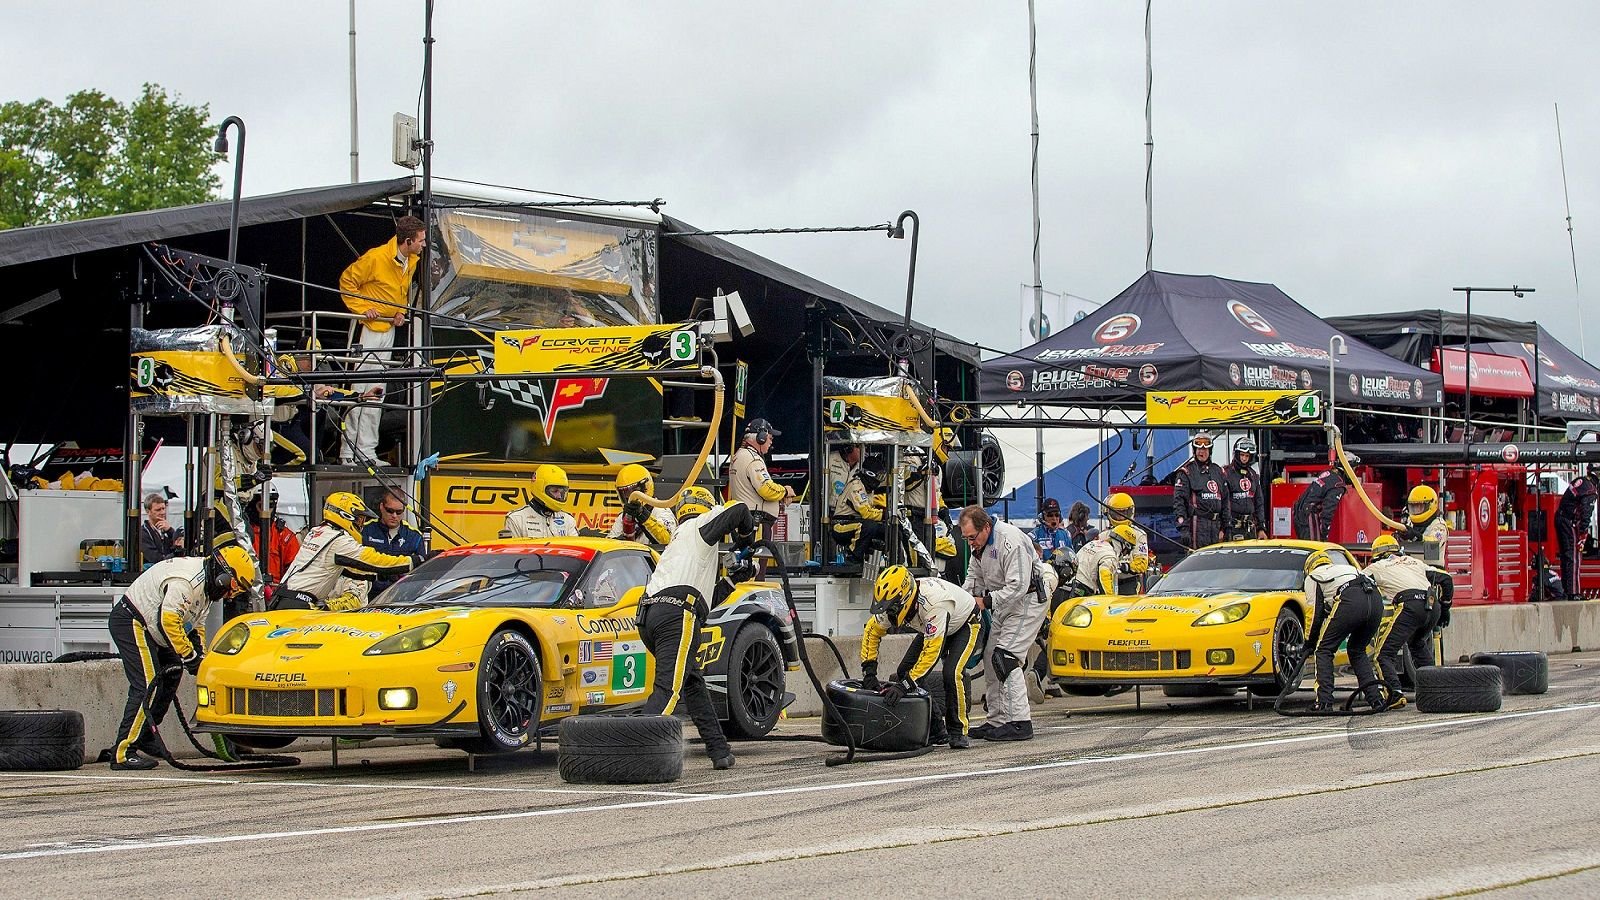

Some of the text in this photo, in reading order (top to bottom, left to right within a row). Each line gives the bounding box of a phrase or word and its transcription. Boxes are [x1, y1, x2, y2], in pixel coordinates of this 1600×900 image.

[541, 336, 632, 347] CORVETTE
[676, 332, 693, 359] 3
[569, 345, 629, 354] RACING
[140, 359, 152, 386] 3
[1142, 367, 1154, 385] 5
[1245, 378, 1297, 390] MOTORSPORTS
[1362, 388, 1411, 400] MOTORSPORTS
[1187, 398, 1265, 406] CORVETTE
[1302, 396, 1316, 417] 4
[832, 401, 843, 422] 4
[1519, 448, 1587, 458] motorspots
[446, 485, 623, 506] CORTTE
[577, 614, 638, 639] Compuw
[1107, 639, 1151, 647] FLEXFUEL
[254, 672, 308, 682] FLEXFUEL
[623, 655, 636, 688] 3
